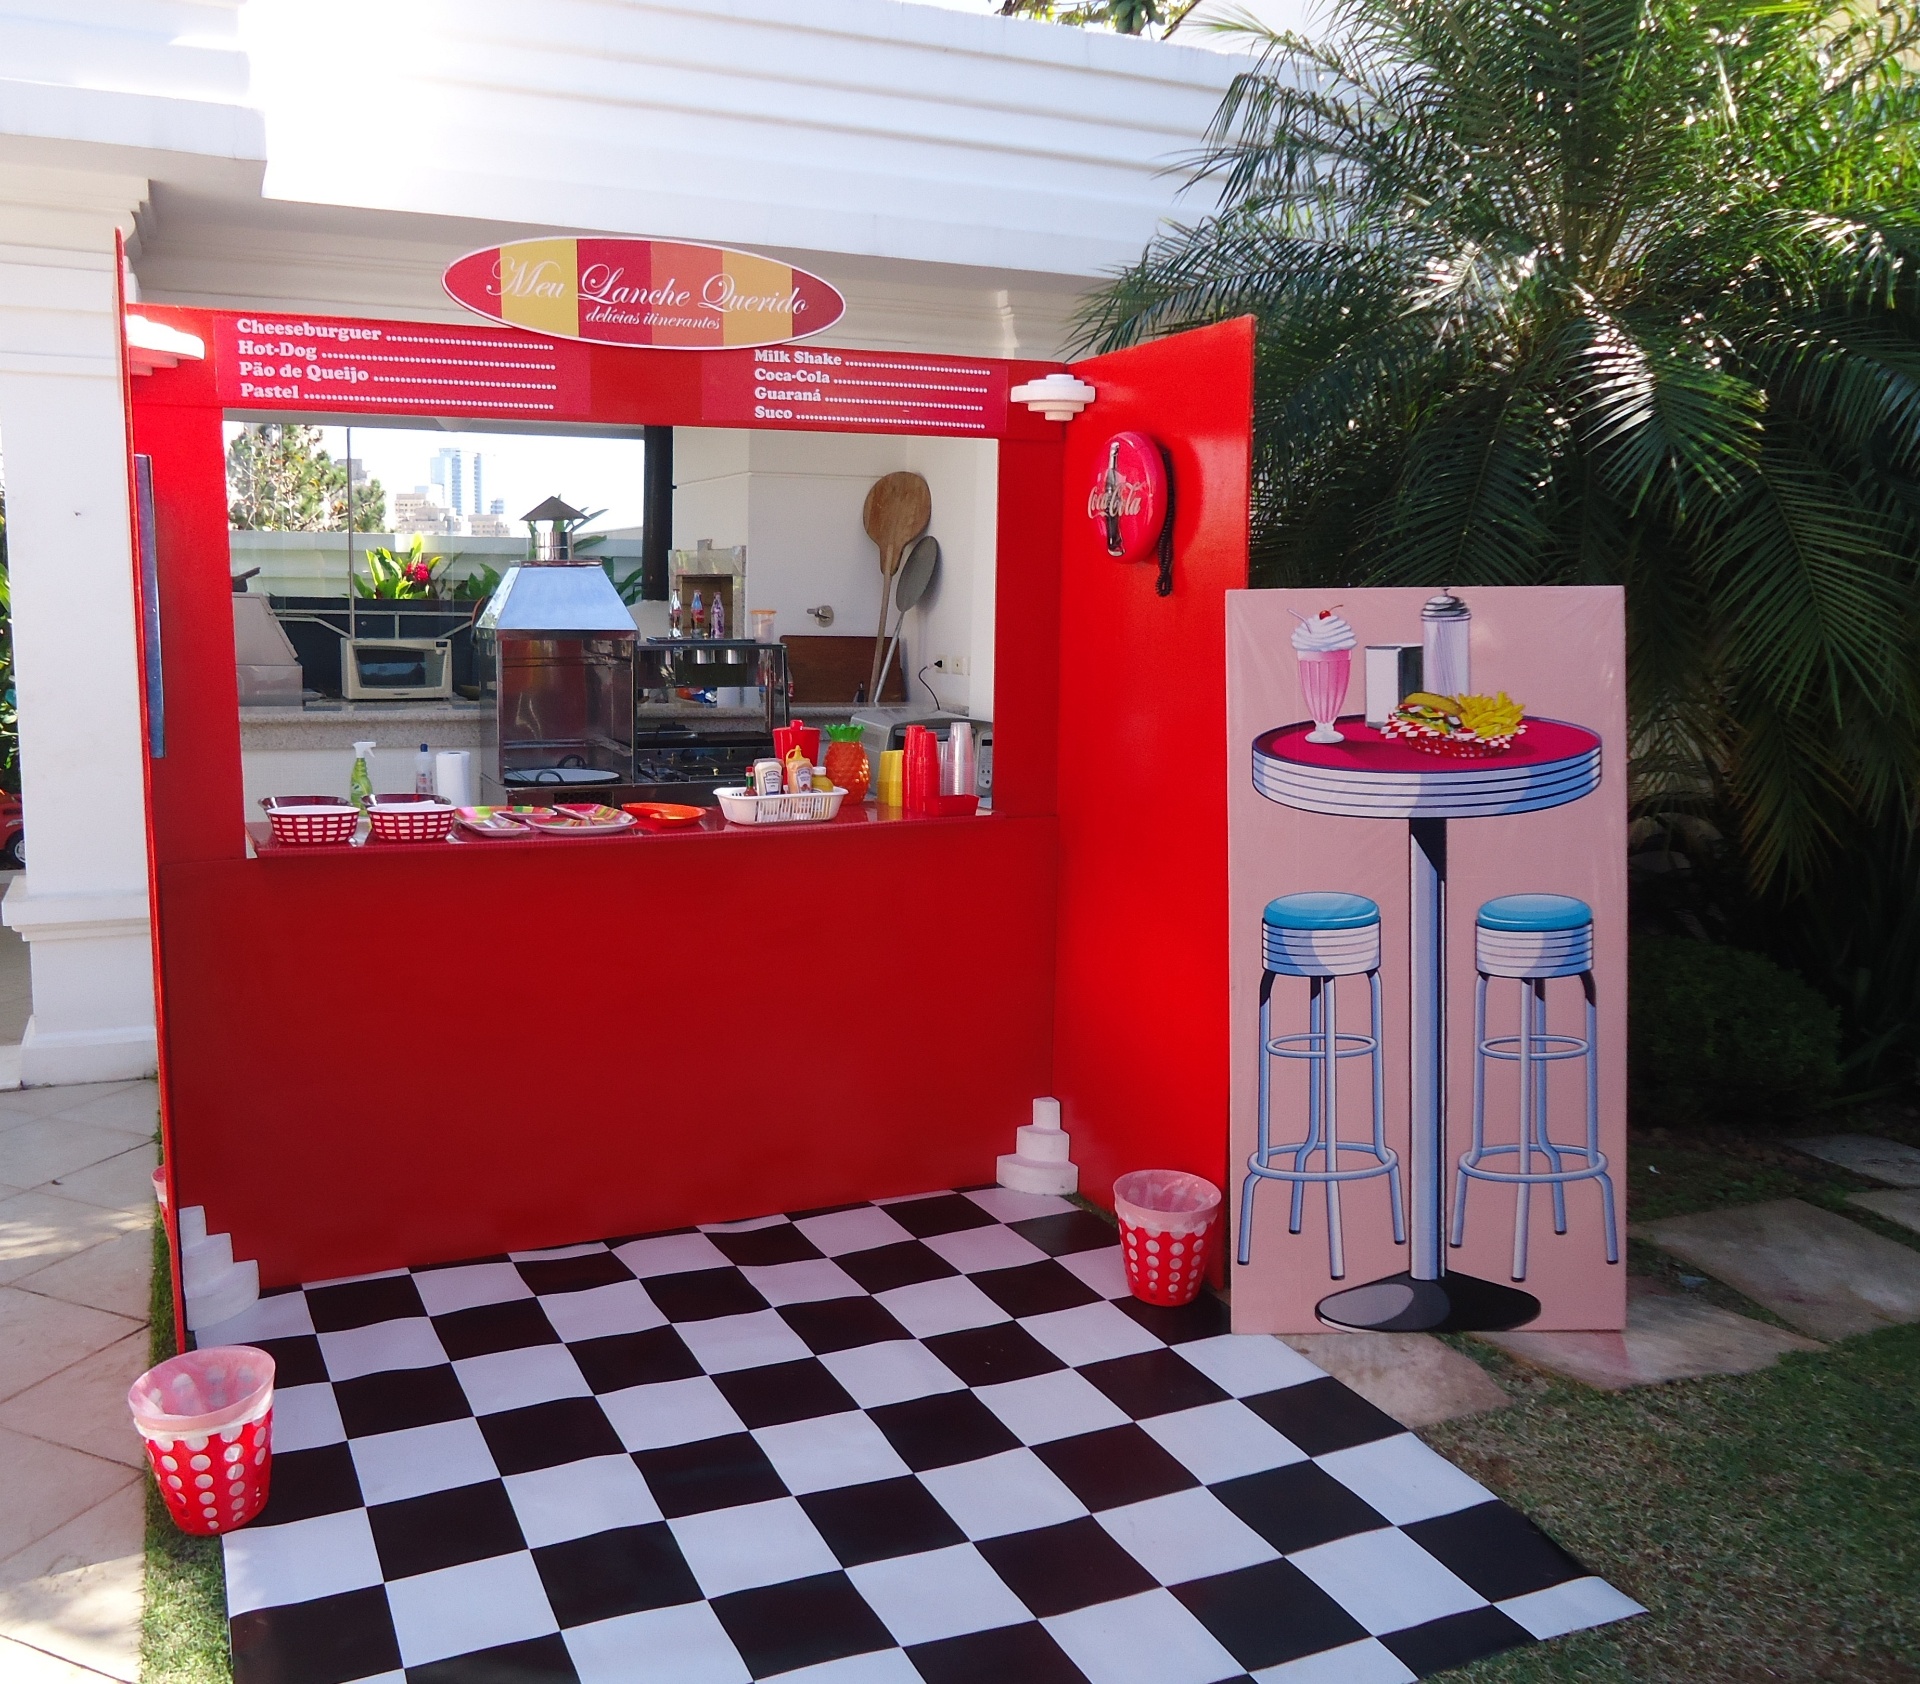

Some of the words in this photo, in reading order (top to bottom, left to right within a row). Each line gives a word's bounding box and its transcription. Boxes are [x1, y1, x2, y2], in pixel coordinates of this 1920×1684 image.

[485, 257, 565, 299] Meu
[577, 263, 690, 307] Lanche
[697, 273, 809, 315] Querido
[585, 306, 641, 326] delícias
[642, 309, 721, 330] itinerantes
[236, 319, 382, 342] Cheeseburguer
[237, 341, 318, 361] Hot-Dog
[754, 349, 791, 363] Milk
[793, 351, 842, 366] Shake
[239, 361, 275, 378] Pão
[279, 363, 302, 379] de
[305, 365, 369, 384] Queijo
[754, 367, 830, 384] Coca-Cola
[240, 382, 299, 399] Pastel
[754, 387, 822, 402] Guaraná
[754, 405, 793, 420] Suco
[1088, 481, 1145, 518] Coca-Cola
